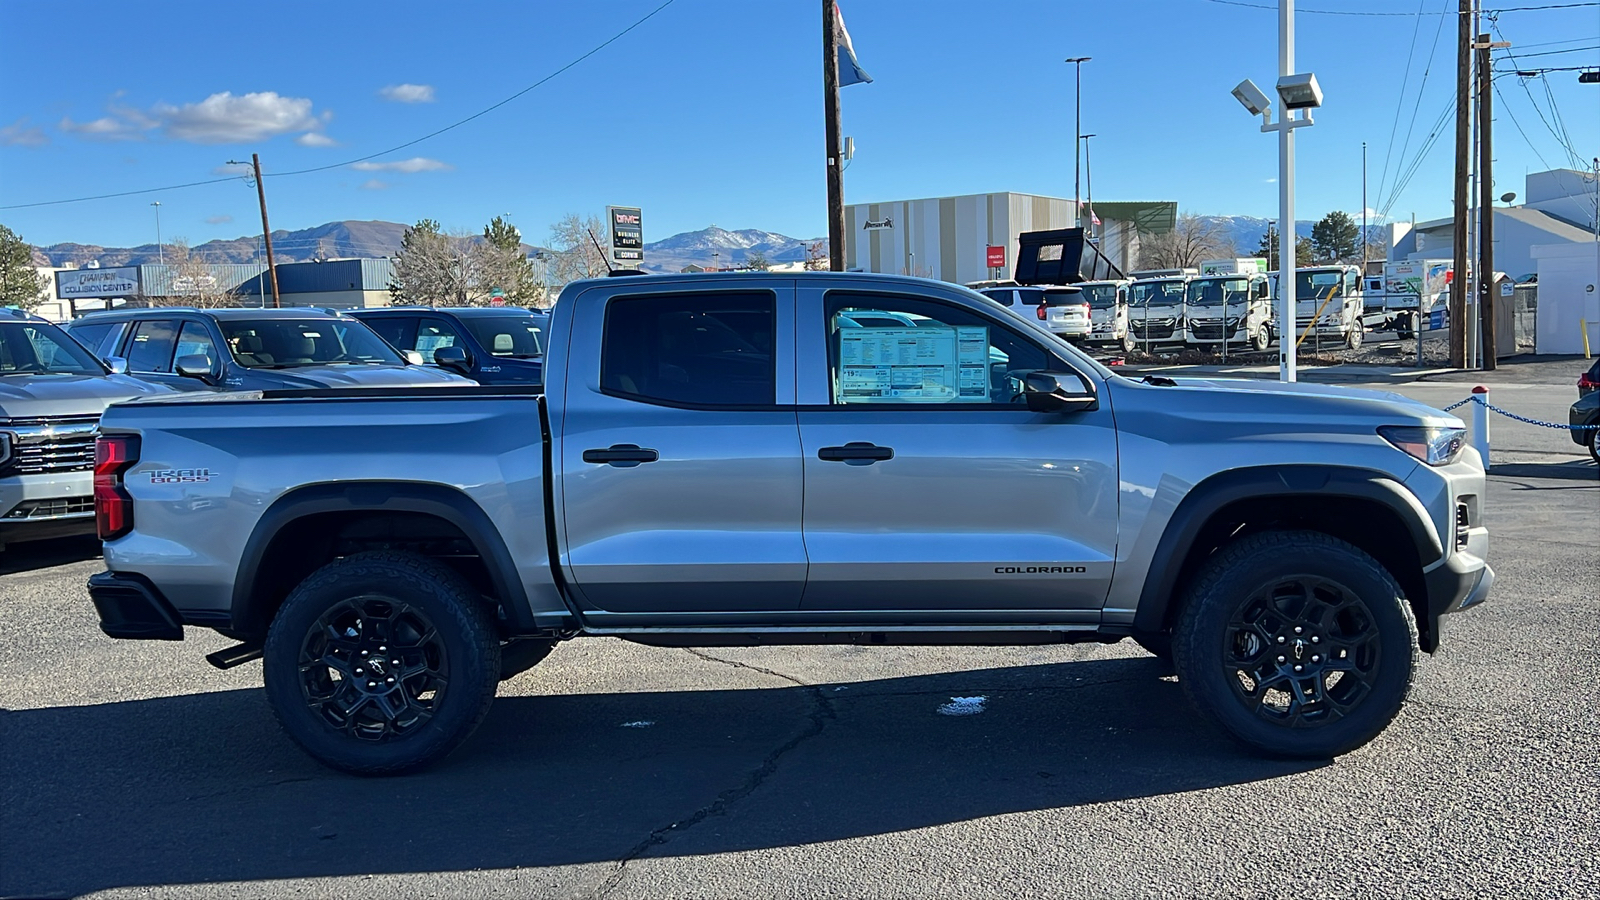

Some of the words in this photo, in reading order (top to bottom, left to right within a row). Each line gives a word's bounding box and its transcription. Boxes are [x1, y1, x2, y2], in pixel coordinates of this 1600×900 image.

[79, 272, 116, 285] CHAMPION
[64, 285, 101, 294] COLLISION
[102, 283, 133, 292] CENTER
[139, 468, 219, 478] TRAIL
[994, 566, 1087, 574] COLORADO
